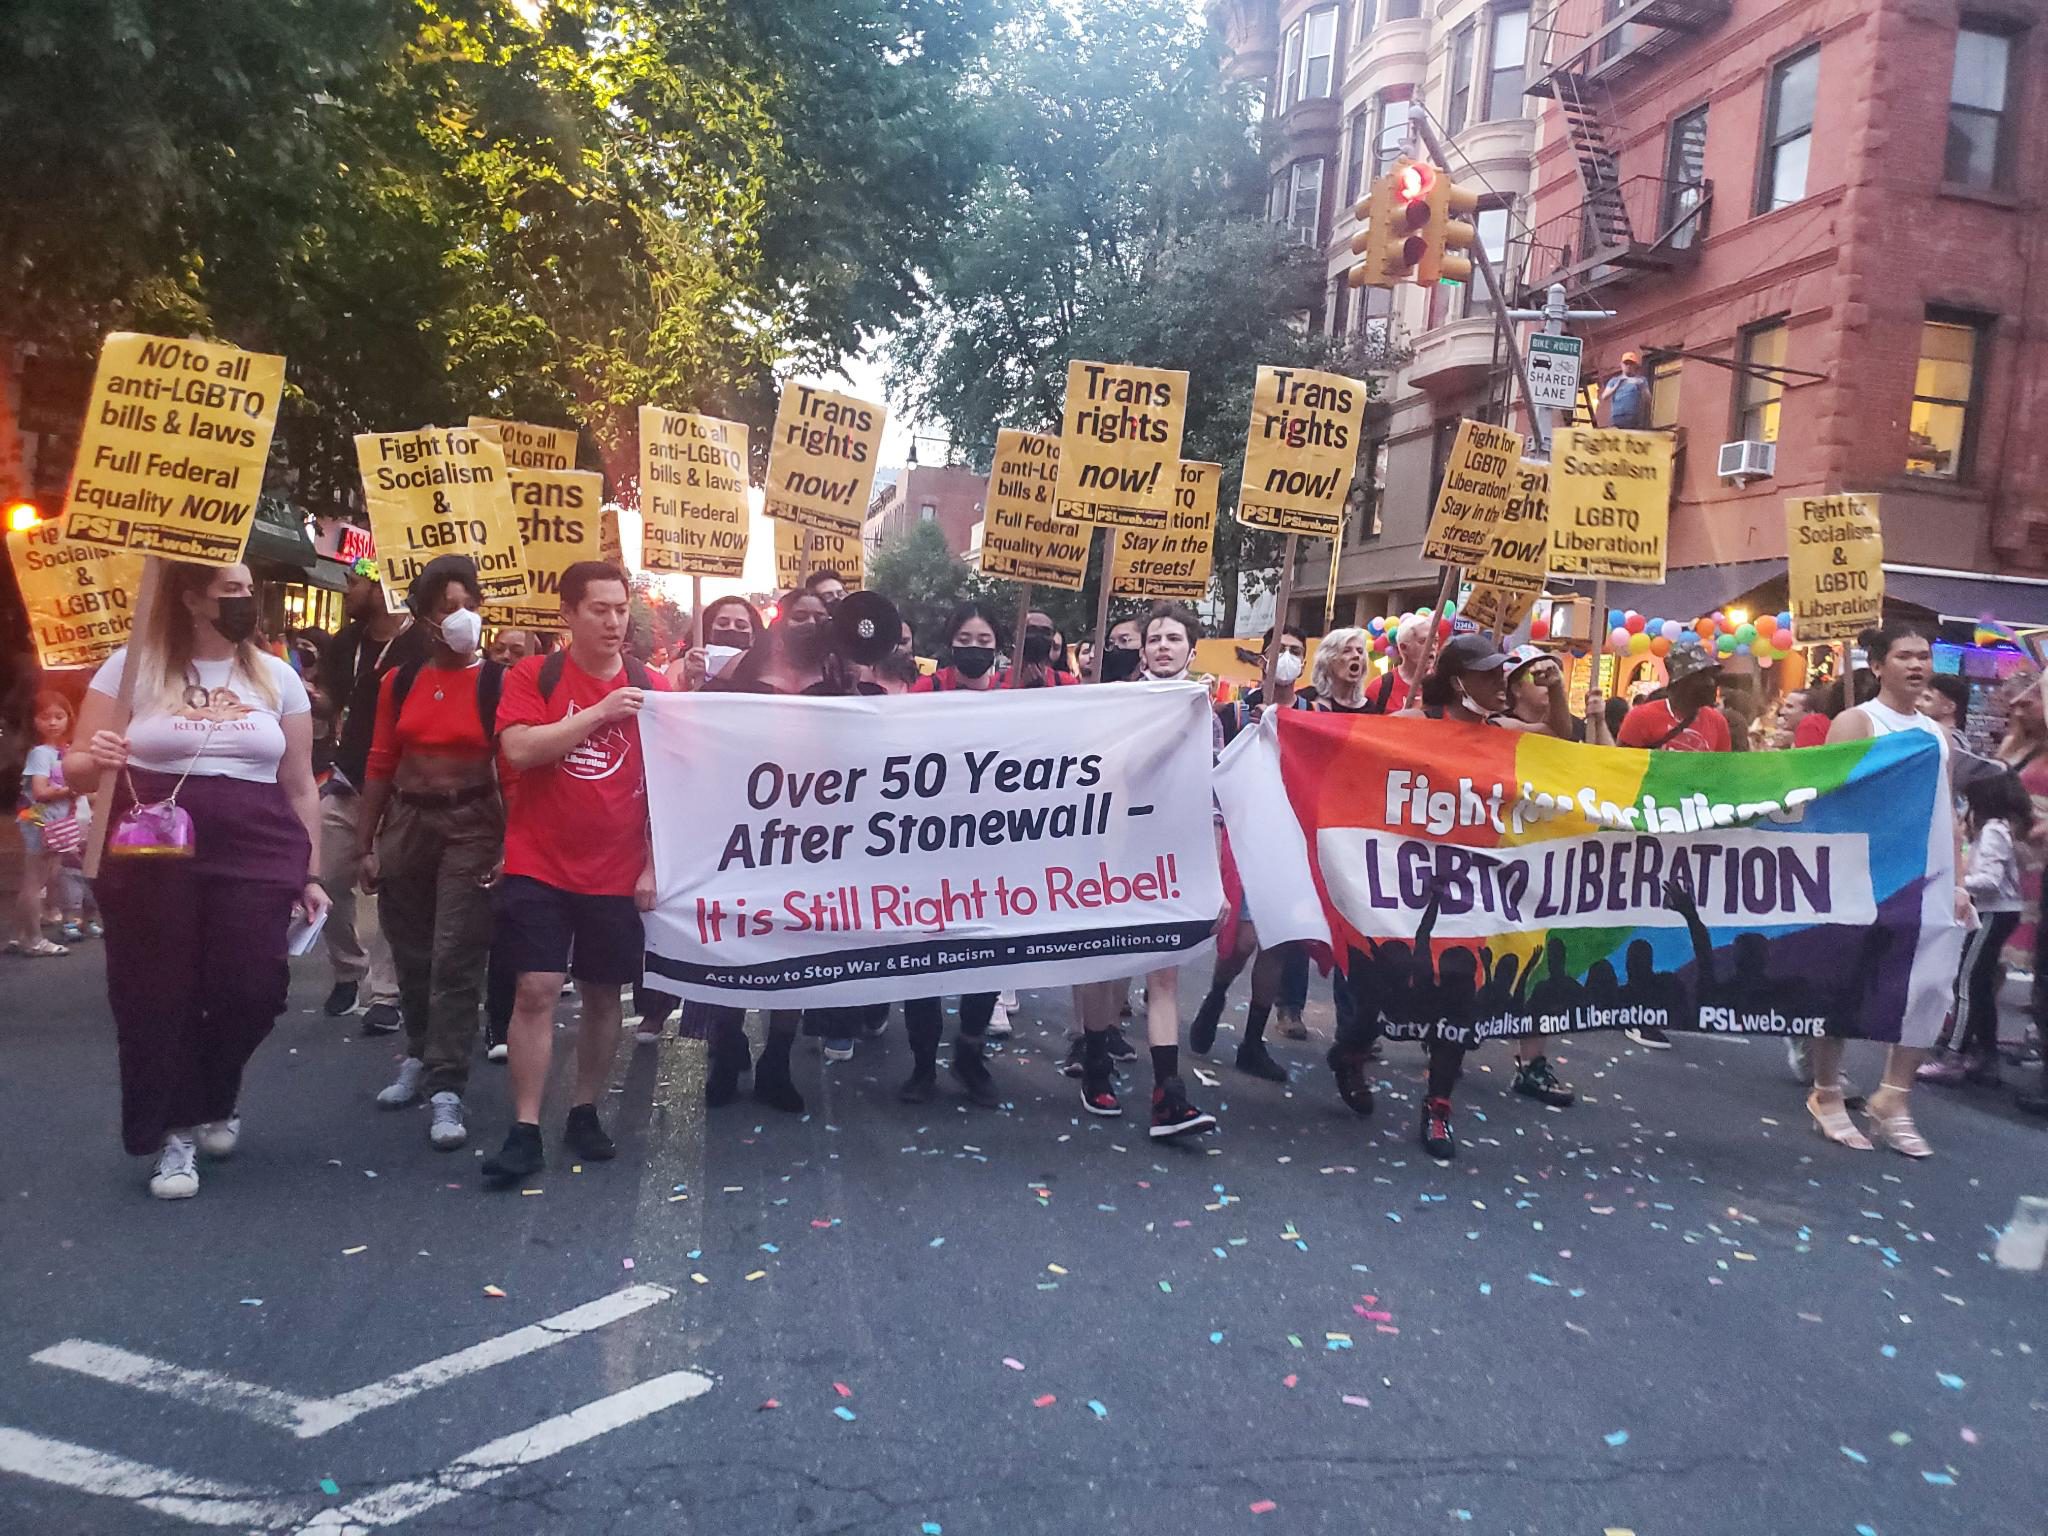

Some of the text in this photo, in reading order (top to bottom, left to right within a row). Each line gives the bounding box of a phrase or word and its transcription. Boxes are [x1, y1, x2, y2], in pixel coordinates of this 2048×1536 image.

[1532, 339, 1578, 353] BIKE ROUTE
[138, 341, 250, 382] NO to all
[1085, 366, 1171, 407] Trans
[1273, 370, 1353, 413] Trans
[1530, 371, 1575, 386] SHARED
[1534, 386, 1566, 400] LANE
[107, 375, 265, 419] anti-LGBTQ
[798, 386, 873, 433] Trans
[100, 400, 256, 448] bills & laws
[662, 415, 728, 443] NO to all
[1076, 406, 1169, 443] rights
[1264, 410, 1348, 449] rights
[1467, 424, 1500, 450] Fight
[1501, 432, 1515, 453] for
[379, 433, 480, 463] Fight for
[516, 431, 532, 446] to
[537, 433, 556, 449] all
[787, 421, 868, 463] rights
[1019, 437, 1060, 459] NO to
[1573, 432, 1620, 455] Fight
[1626, 434, 1651, 455] for
[94, 444, 239, 489] Full Federal
[649, 441, 741, 472] anti-LGBTQ
[1001, 460, 1058, 481] anti-LG
[1464, 450, 1507, 479] LGBTQ
[1564, 455, 1657, 480] Socialism
[377, 461, 493, 490] Socialism
[650, 462, 742, 493] bills & laws
[785, 471, 859, 505] now!
[1079, 463, 1162, 495] now!
[1180, 464, 1205, 484] for
[1264, 468, 1341, 500] now!
[1448, 470, 1511, 500] Liberation!
[74, 480, 250, 526] Equality NOW
[433, 490, 452, 513] &
[509, 477, 583, 508] rans
[997, 480, 1031, 501] bills
[1035, 485, 1047, 503] &
[1602, 481, 1617, 501] &
[652, 496, 739, 524] Full Federal
[765, 500, 798, 521] PSL
[1058, 501, 1094, 520] PSL
[1097, 510, 1167, 529] PSLweb.org
[1242, 504, 1281, 524] PSL
[1441, 496, 1472, 521] Stay
[1472, 502, 1484, 521] in
[1575, 506, 1639, 532] LGBTQ
[1803, 499, 1844, 522] Fight
[28, 527, 59, 545] Fig
[71, 514, 126, 545] PSL
[406, 520, 487, 549] LGBTQ
[517, 508, 584, 546] ghts
[644, 523, 705, 550] Equality
[710, 530, 748, 551] NOW
[995, 509, 1080, 538] Full Federal
[1800, 521, 1873, 544] Socialism
[26, 545, 116, 570] Socialis
[794, 534, 844, 553] LBTQ
[984, 532, 1086, 561] Equality NOW
[1122, 532, 1208, 554] Stay in the
[1554, 530, 1658, 556] Liberation!
[1832, 547, 1848, 566] &
[386, 545, 518, 582] Libion!
[645, 549, 680, 569] PSL
[779, 555, 859, 571] Libration!
[984, 555, 1017, 573] PSL
[1130, 560, 1196, 577] streets!
[76, 567, 94, 586] &
[1114, 578, 1143, 592] PSL
[1815, 570, 1868, 594] LGBTQ
[56, 588, 127, 618] LGBTQ
[747, 750, 1103, 811] Over 50 Years
[1385, 770, 1506, 835] Fight
[717, 818, 853, 871] After
[865, 792, 1113, 858] Stonewall
[1364, 836, 1833, 923] LGBTQ LIBERATION
[696, 853, 1182, 945] It is Still Right to Rebel!
[705, 931, 1182, 985] Act Now to Stop War & End Racism answercoalition.org
[1436, 1018, 1468, 1043] for
[1474, 1010, 1533, 1044] Scialism
[1539, 1009, 1571, 1033] and
[1575, 1005, 1669, 1030] Liberation
[1700, 1005, 1825, 1038] PSLweb.org
